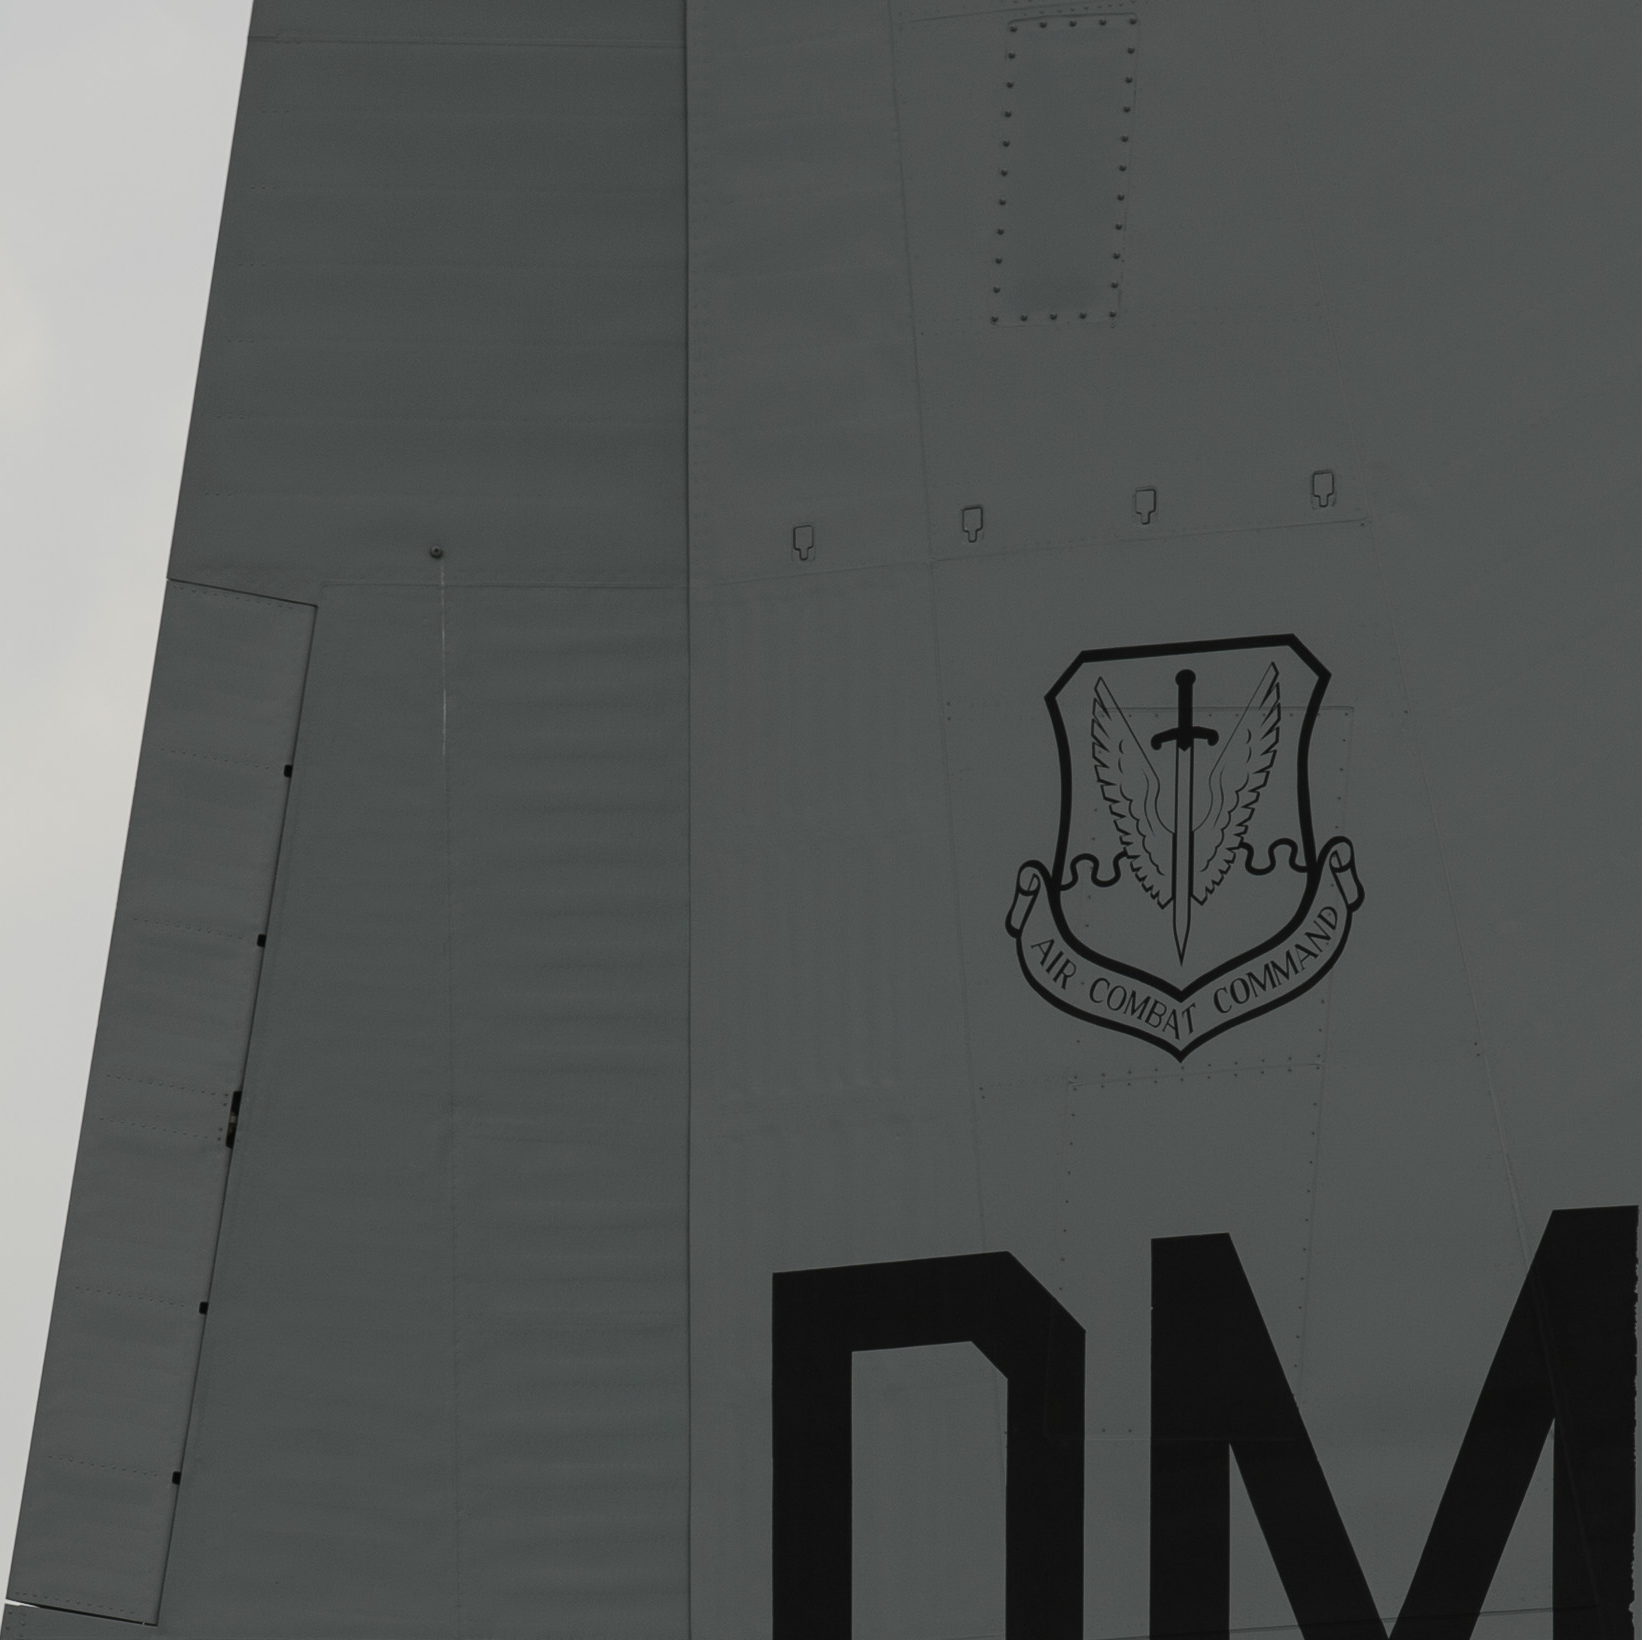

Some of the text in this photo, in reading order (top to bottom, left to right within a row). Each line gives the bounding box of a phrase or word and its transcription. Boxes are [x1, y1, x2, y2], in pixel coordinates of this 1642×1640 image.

[1031, 905, 1339, 1040] AIR COMBAT COMMAND
